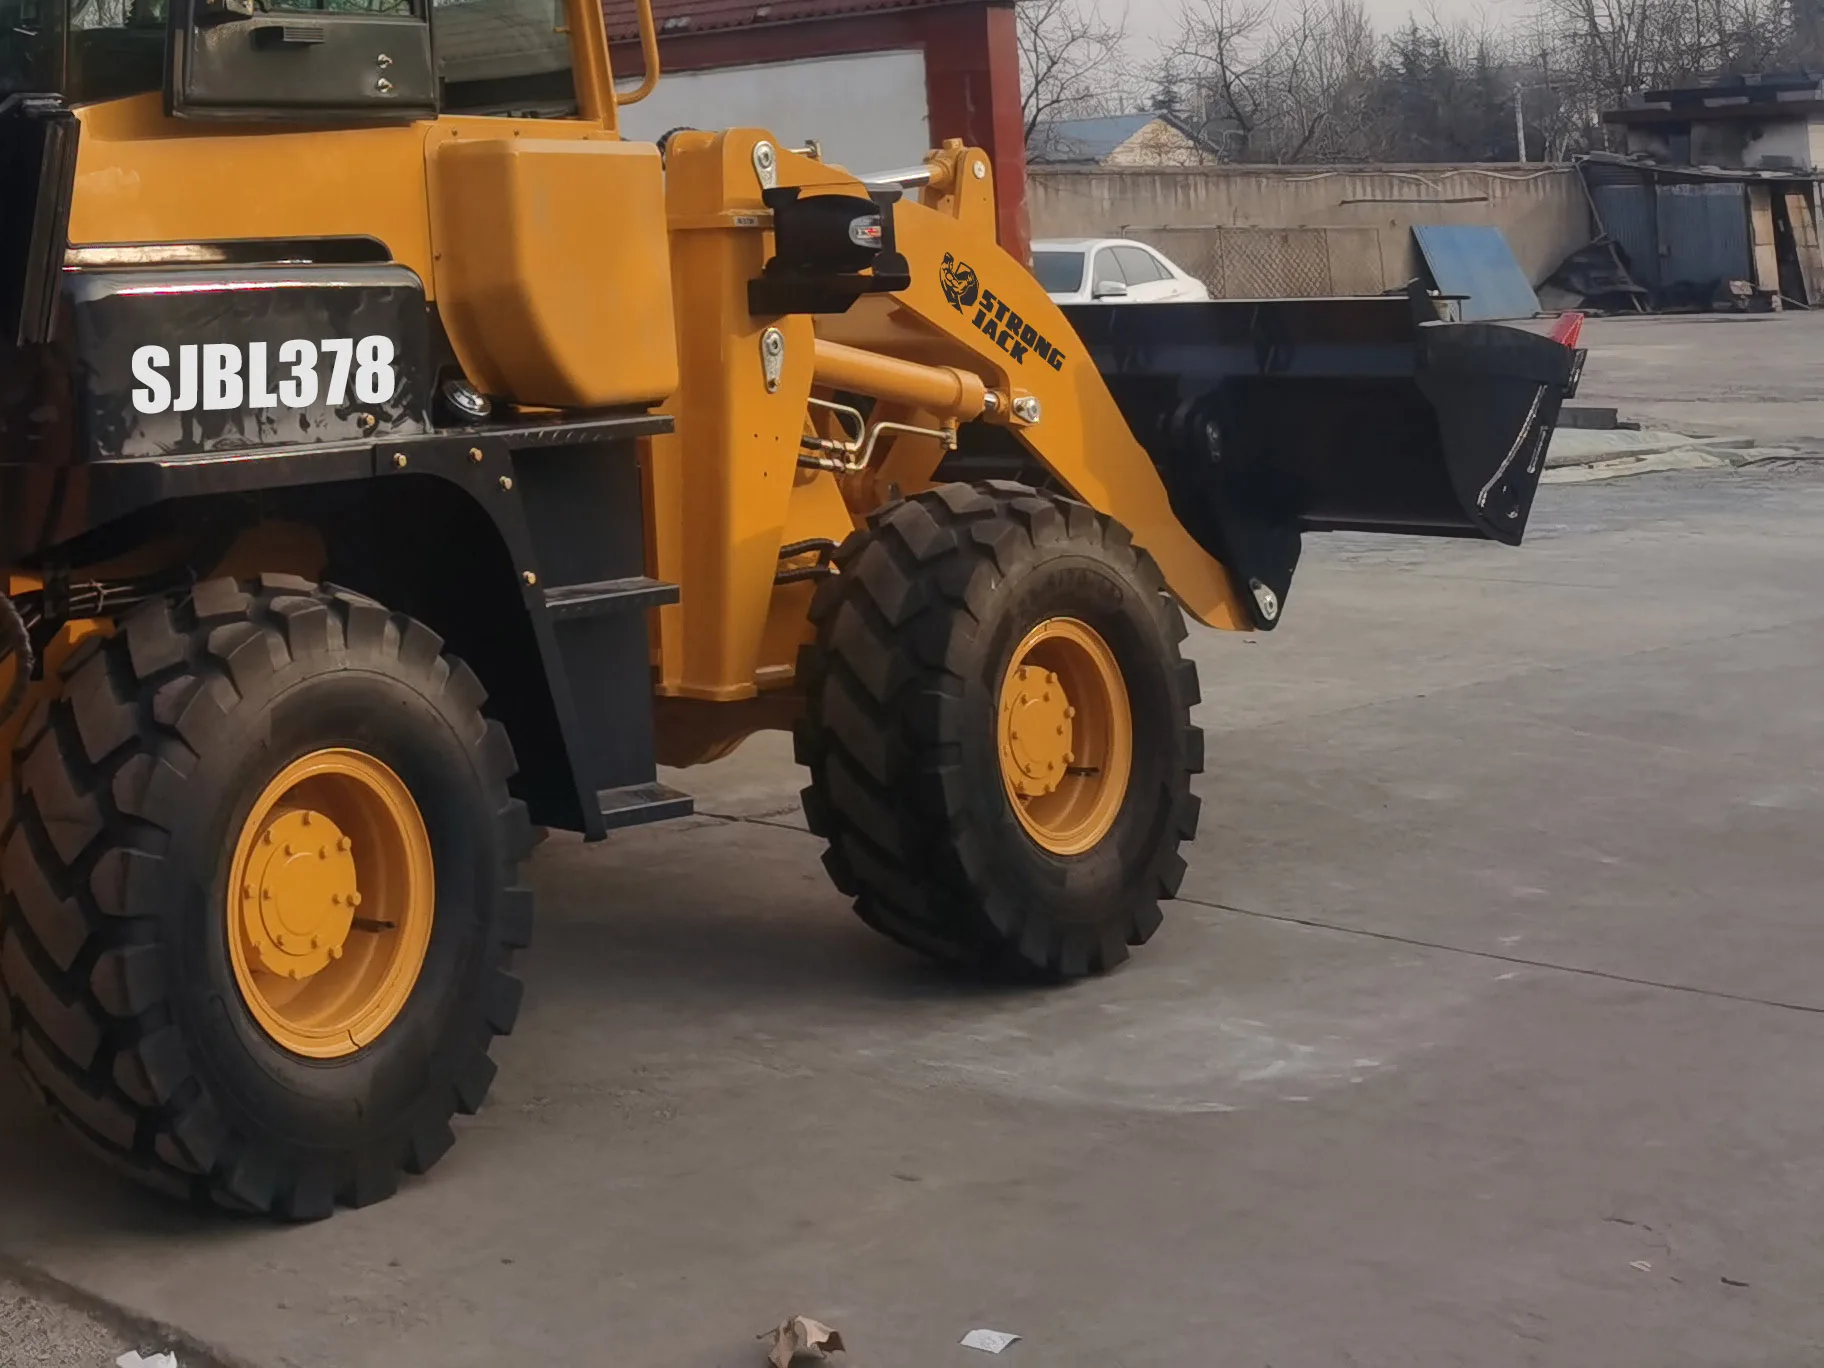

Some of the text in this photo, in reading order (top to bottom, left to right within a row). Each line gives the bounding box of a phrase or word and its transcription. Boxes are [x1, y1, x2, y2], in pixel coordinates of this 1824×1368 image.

[972, 308, 1029, 365] JACK
[979, 289, 1066, 371] STRONG
[131, 335, 395, 415] SJBL378
